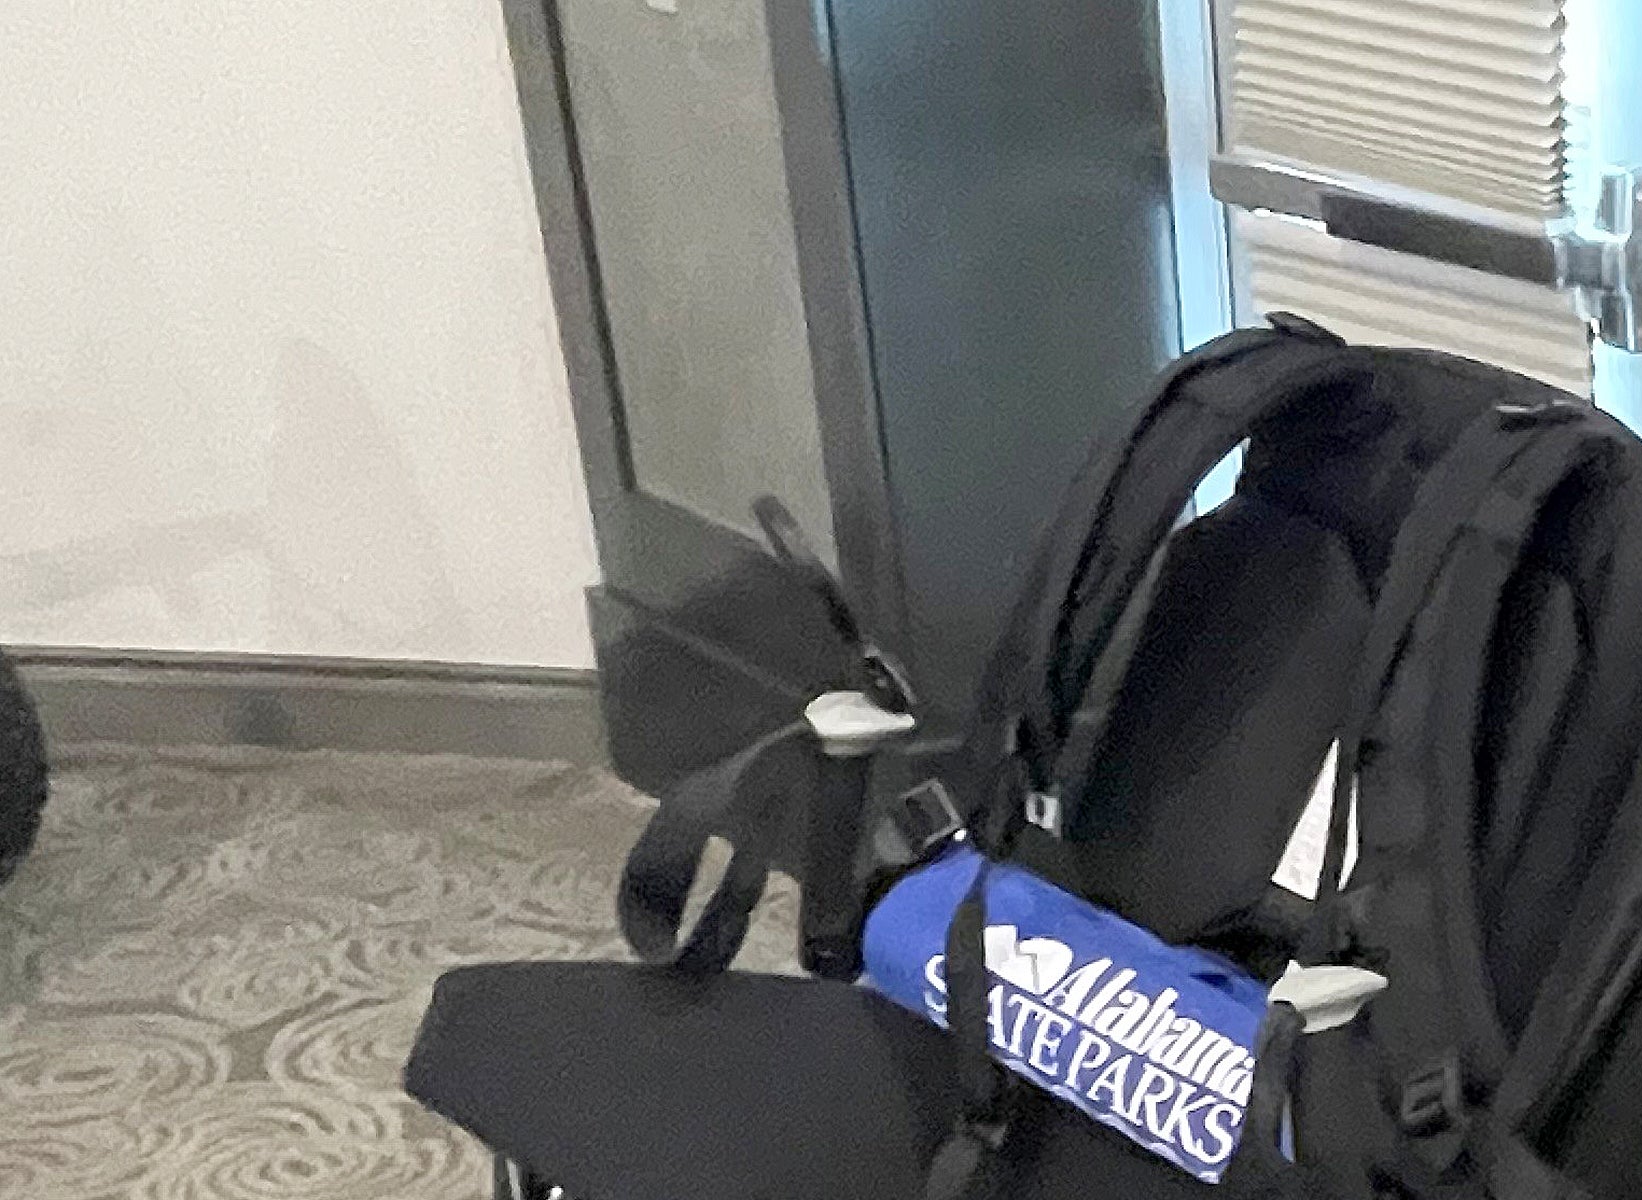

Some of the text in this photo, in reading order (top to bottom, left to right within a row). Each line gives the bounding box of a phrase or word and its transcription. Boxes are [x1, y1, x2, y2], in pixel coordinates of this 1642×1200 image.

[924, 954, 1243, 1165] SATE PARKS
[1041, 957, 1256, 1107] Alabama
